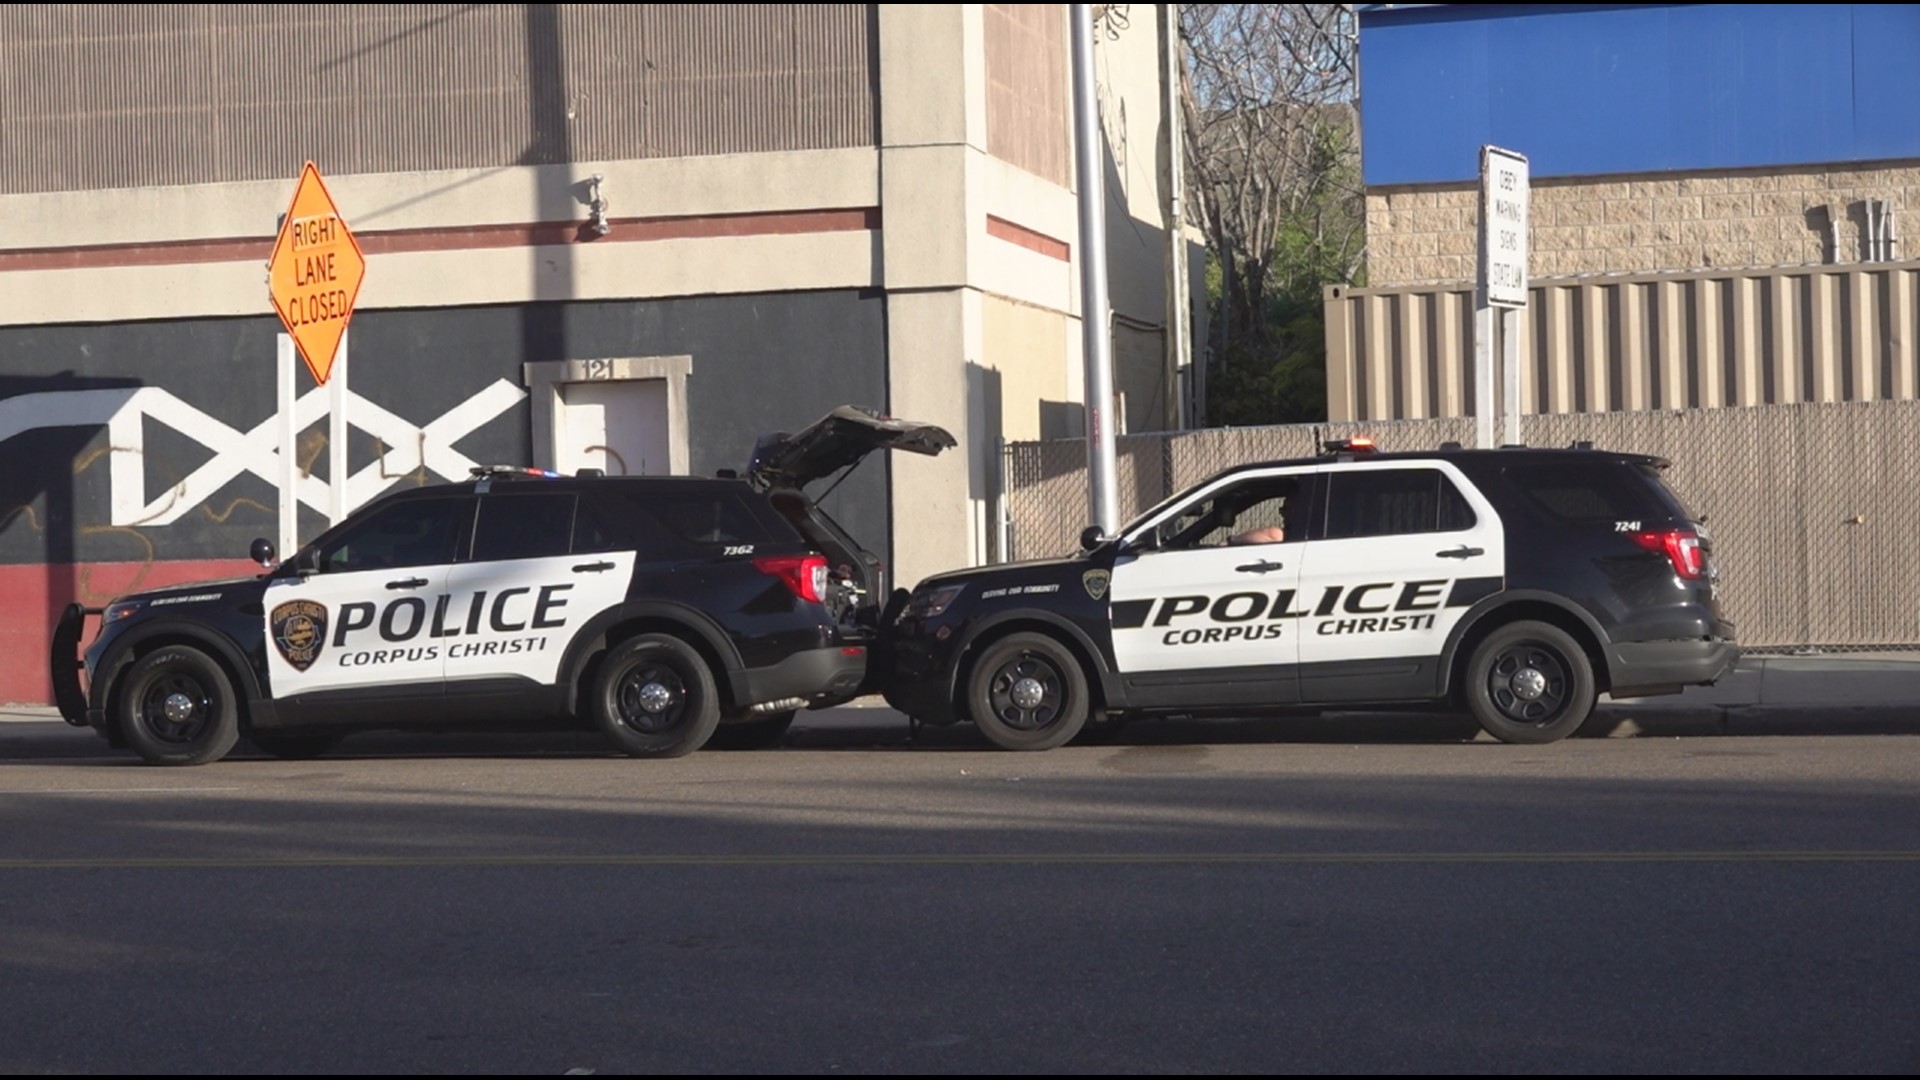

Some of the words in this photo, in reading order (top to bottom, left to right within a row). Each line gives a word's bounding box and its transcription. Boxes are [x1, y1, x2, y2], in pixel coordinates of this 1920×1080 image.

[1500, 169, 1517, 191] OBEY
[1496, 199, 1521, 223] WARNING
[294, 217, 336, 247] RIGHT
[1500, 229, 1517, 251] SIGNS
[294, 253, 337, 287] LANE
[1493, 262, 1510, 288] STATE
[1511, 265, 1522, 289] LAW
[289, 289, 347, 327] CLOSED
[582, 359, 614, 380] 121
[1614, 521, 1641, 532] 7241
[723, 545, 754, 556] 7362
[332, 583, 575, 648] POLICE
[1152, 579, 1449, 628] POLICE
[1162, 623, 1282, 646] CORPUS
[1316, 614, 1436, 636] CHRISTI
[338, 645, 438, 667] CORPUS
[447, 636, 547, 658] CHRISTI
